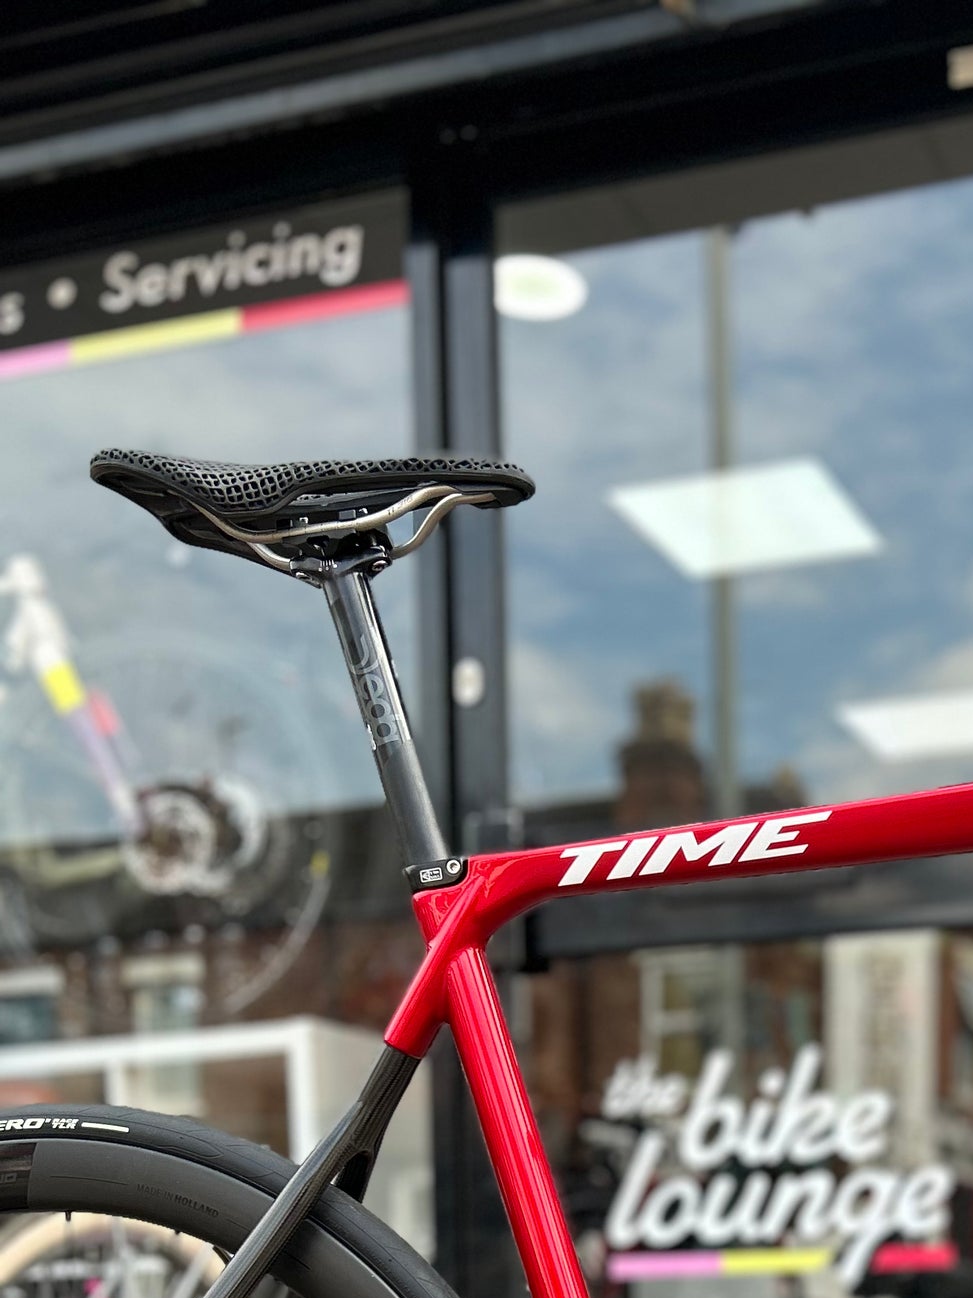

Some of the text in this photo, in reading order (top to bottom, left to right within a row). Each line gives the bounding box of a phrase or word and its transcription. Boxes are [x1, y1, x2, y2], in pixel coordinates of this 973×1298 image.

[99, 221, 364, 313] Servicing
[557, 810, 833, 887] TIME
[603, 1054, 688, 1118] the
[680, 1042, 892, 1169] bike
[136, 1183, 220, 1218] MADE IN HOLLAND
[605, 1131, 957, 1295] lounge
